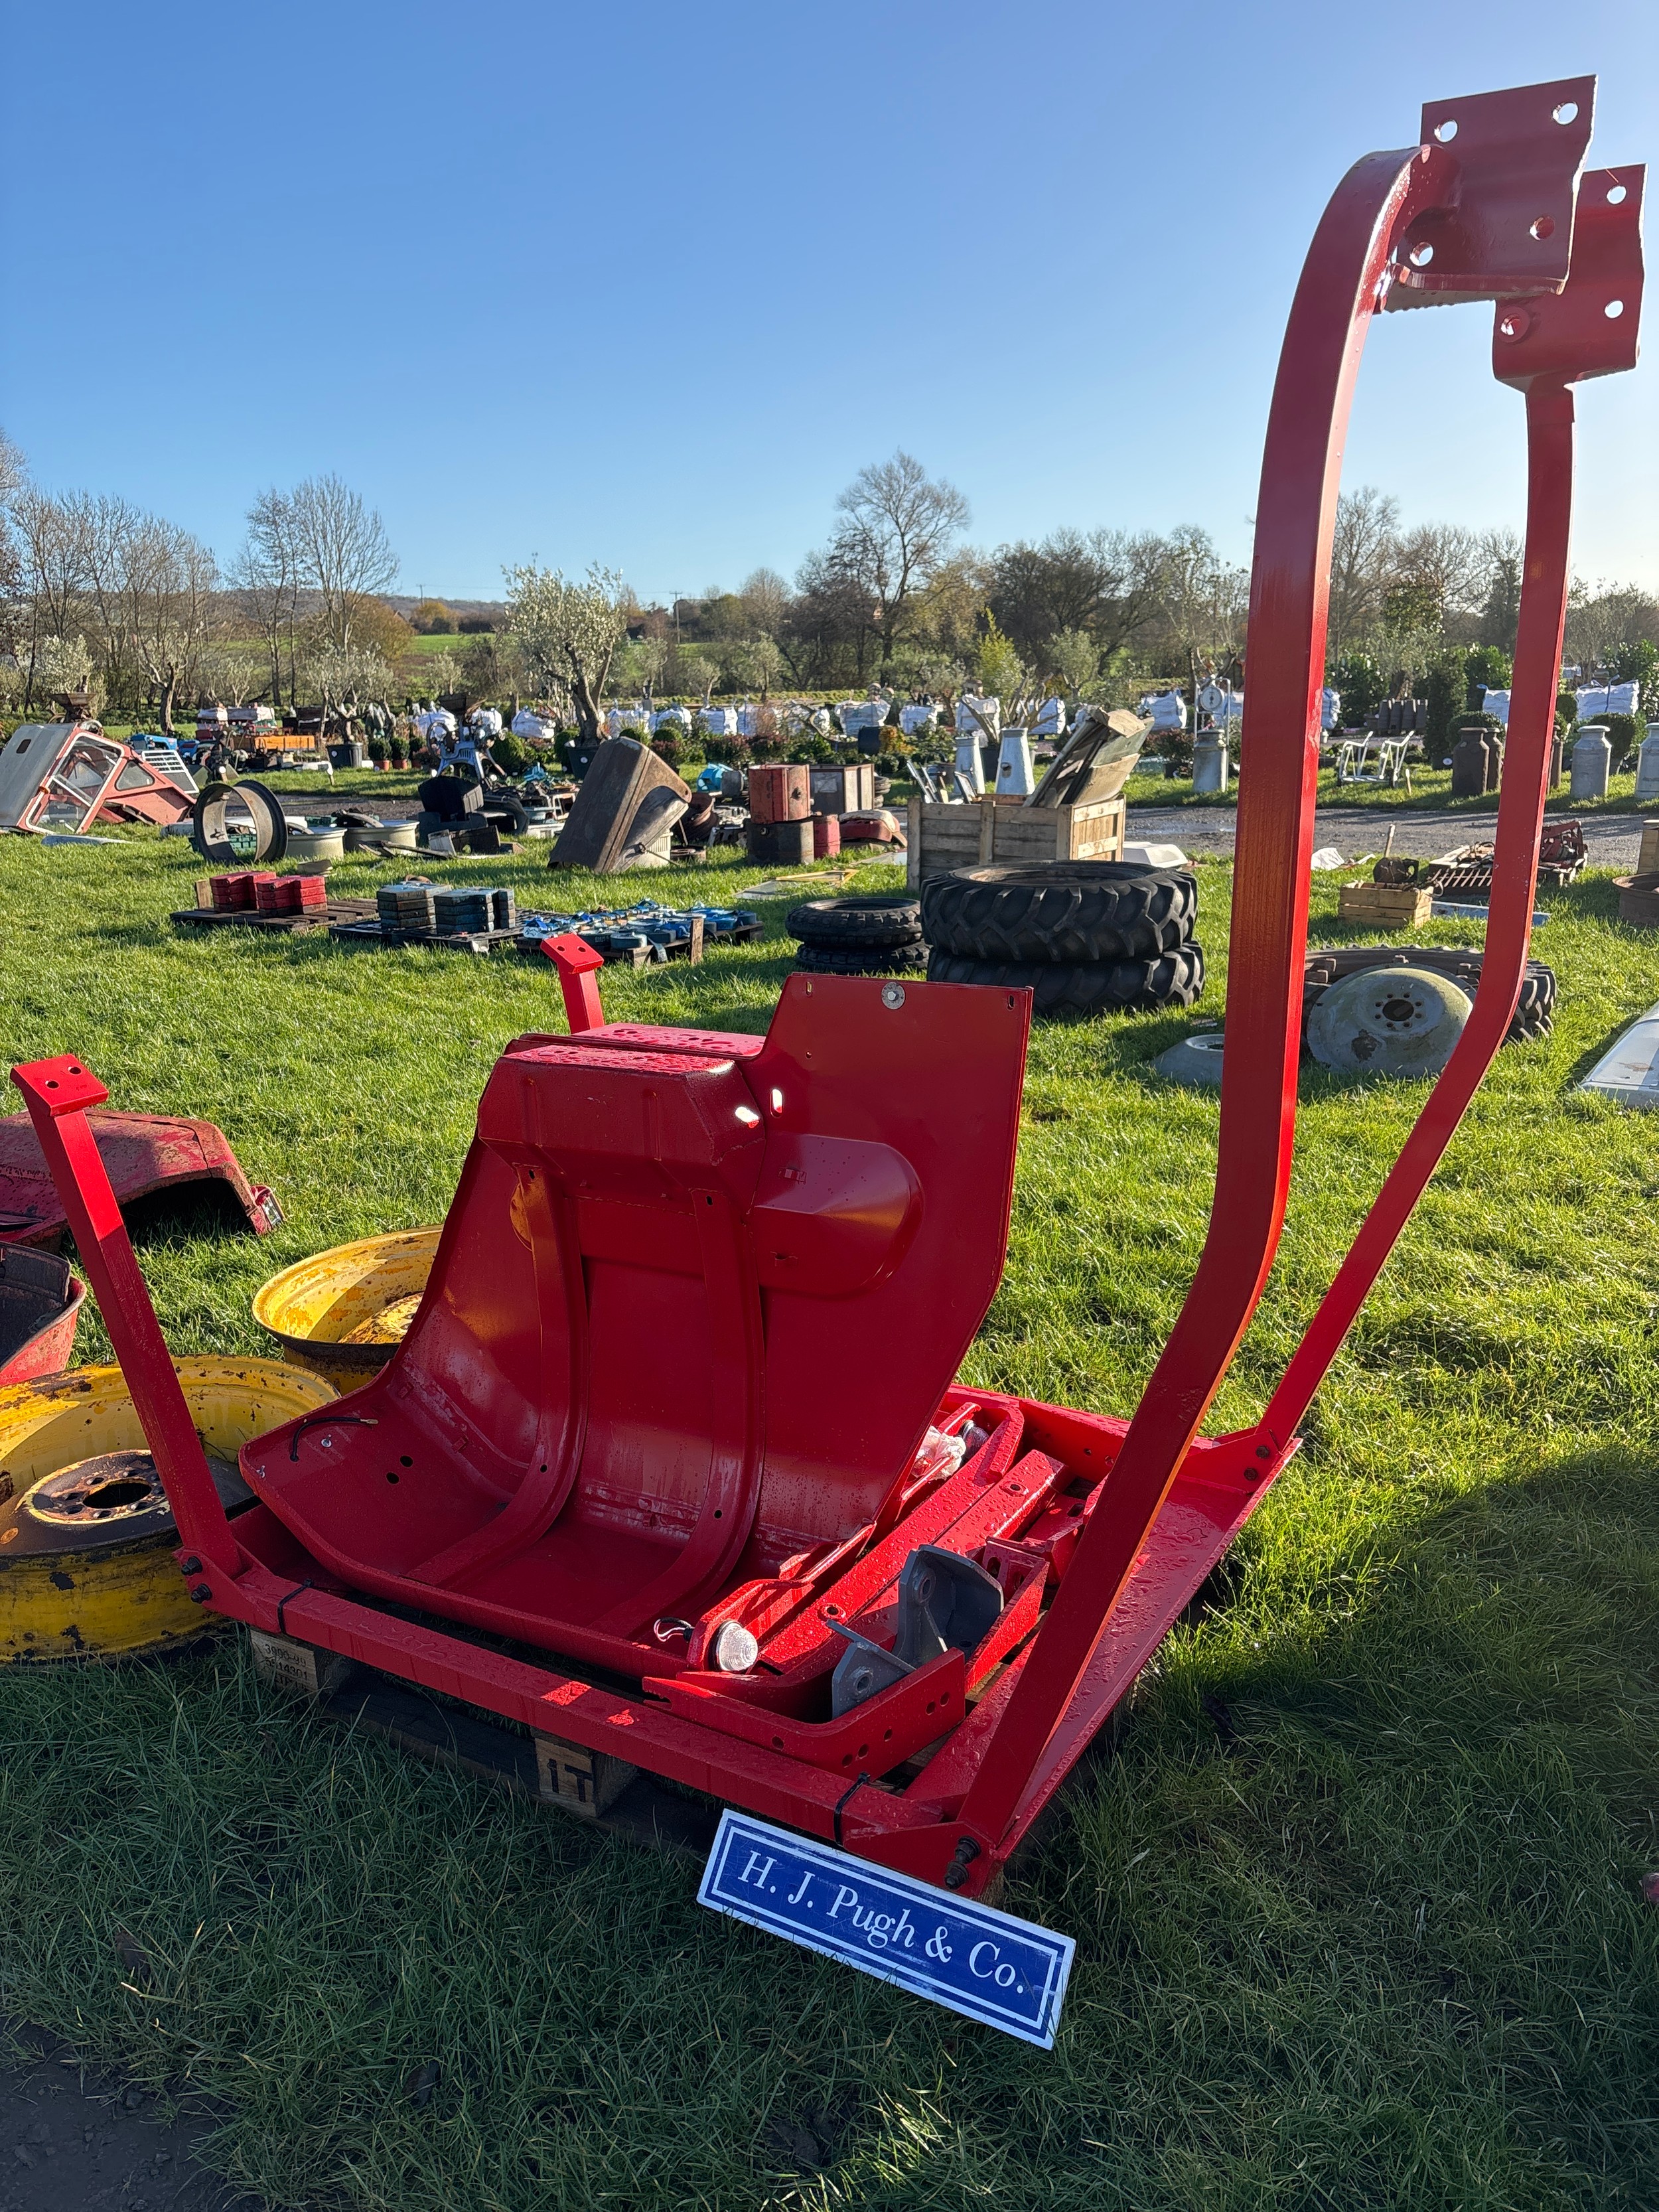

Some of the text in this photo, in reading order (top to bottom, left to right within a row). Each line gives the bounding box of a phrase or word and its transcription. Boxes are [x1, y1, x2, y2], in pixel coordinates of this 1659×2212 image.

[737, 1850, 1024, 1994] H. J. Pugh & Co.
